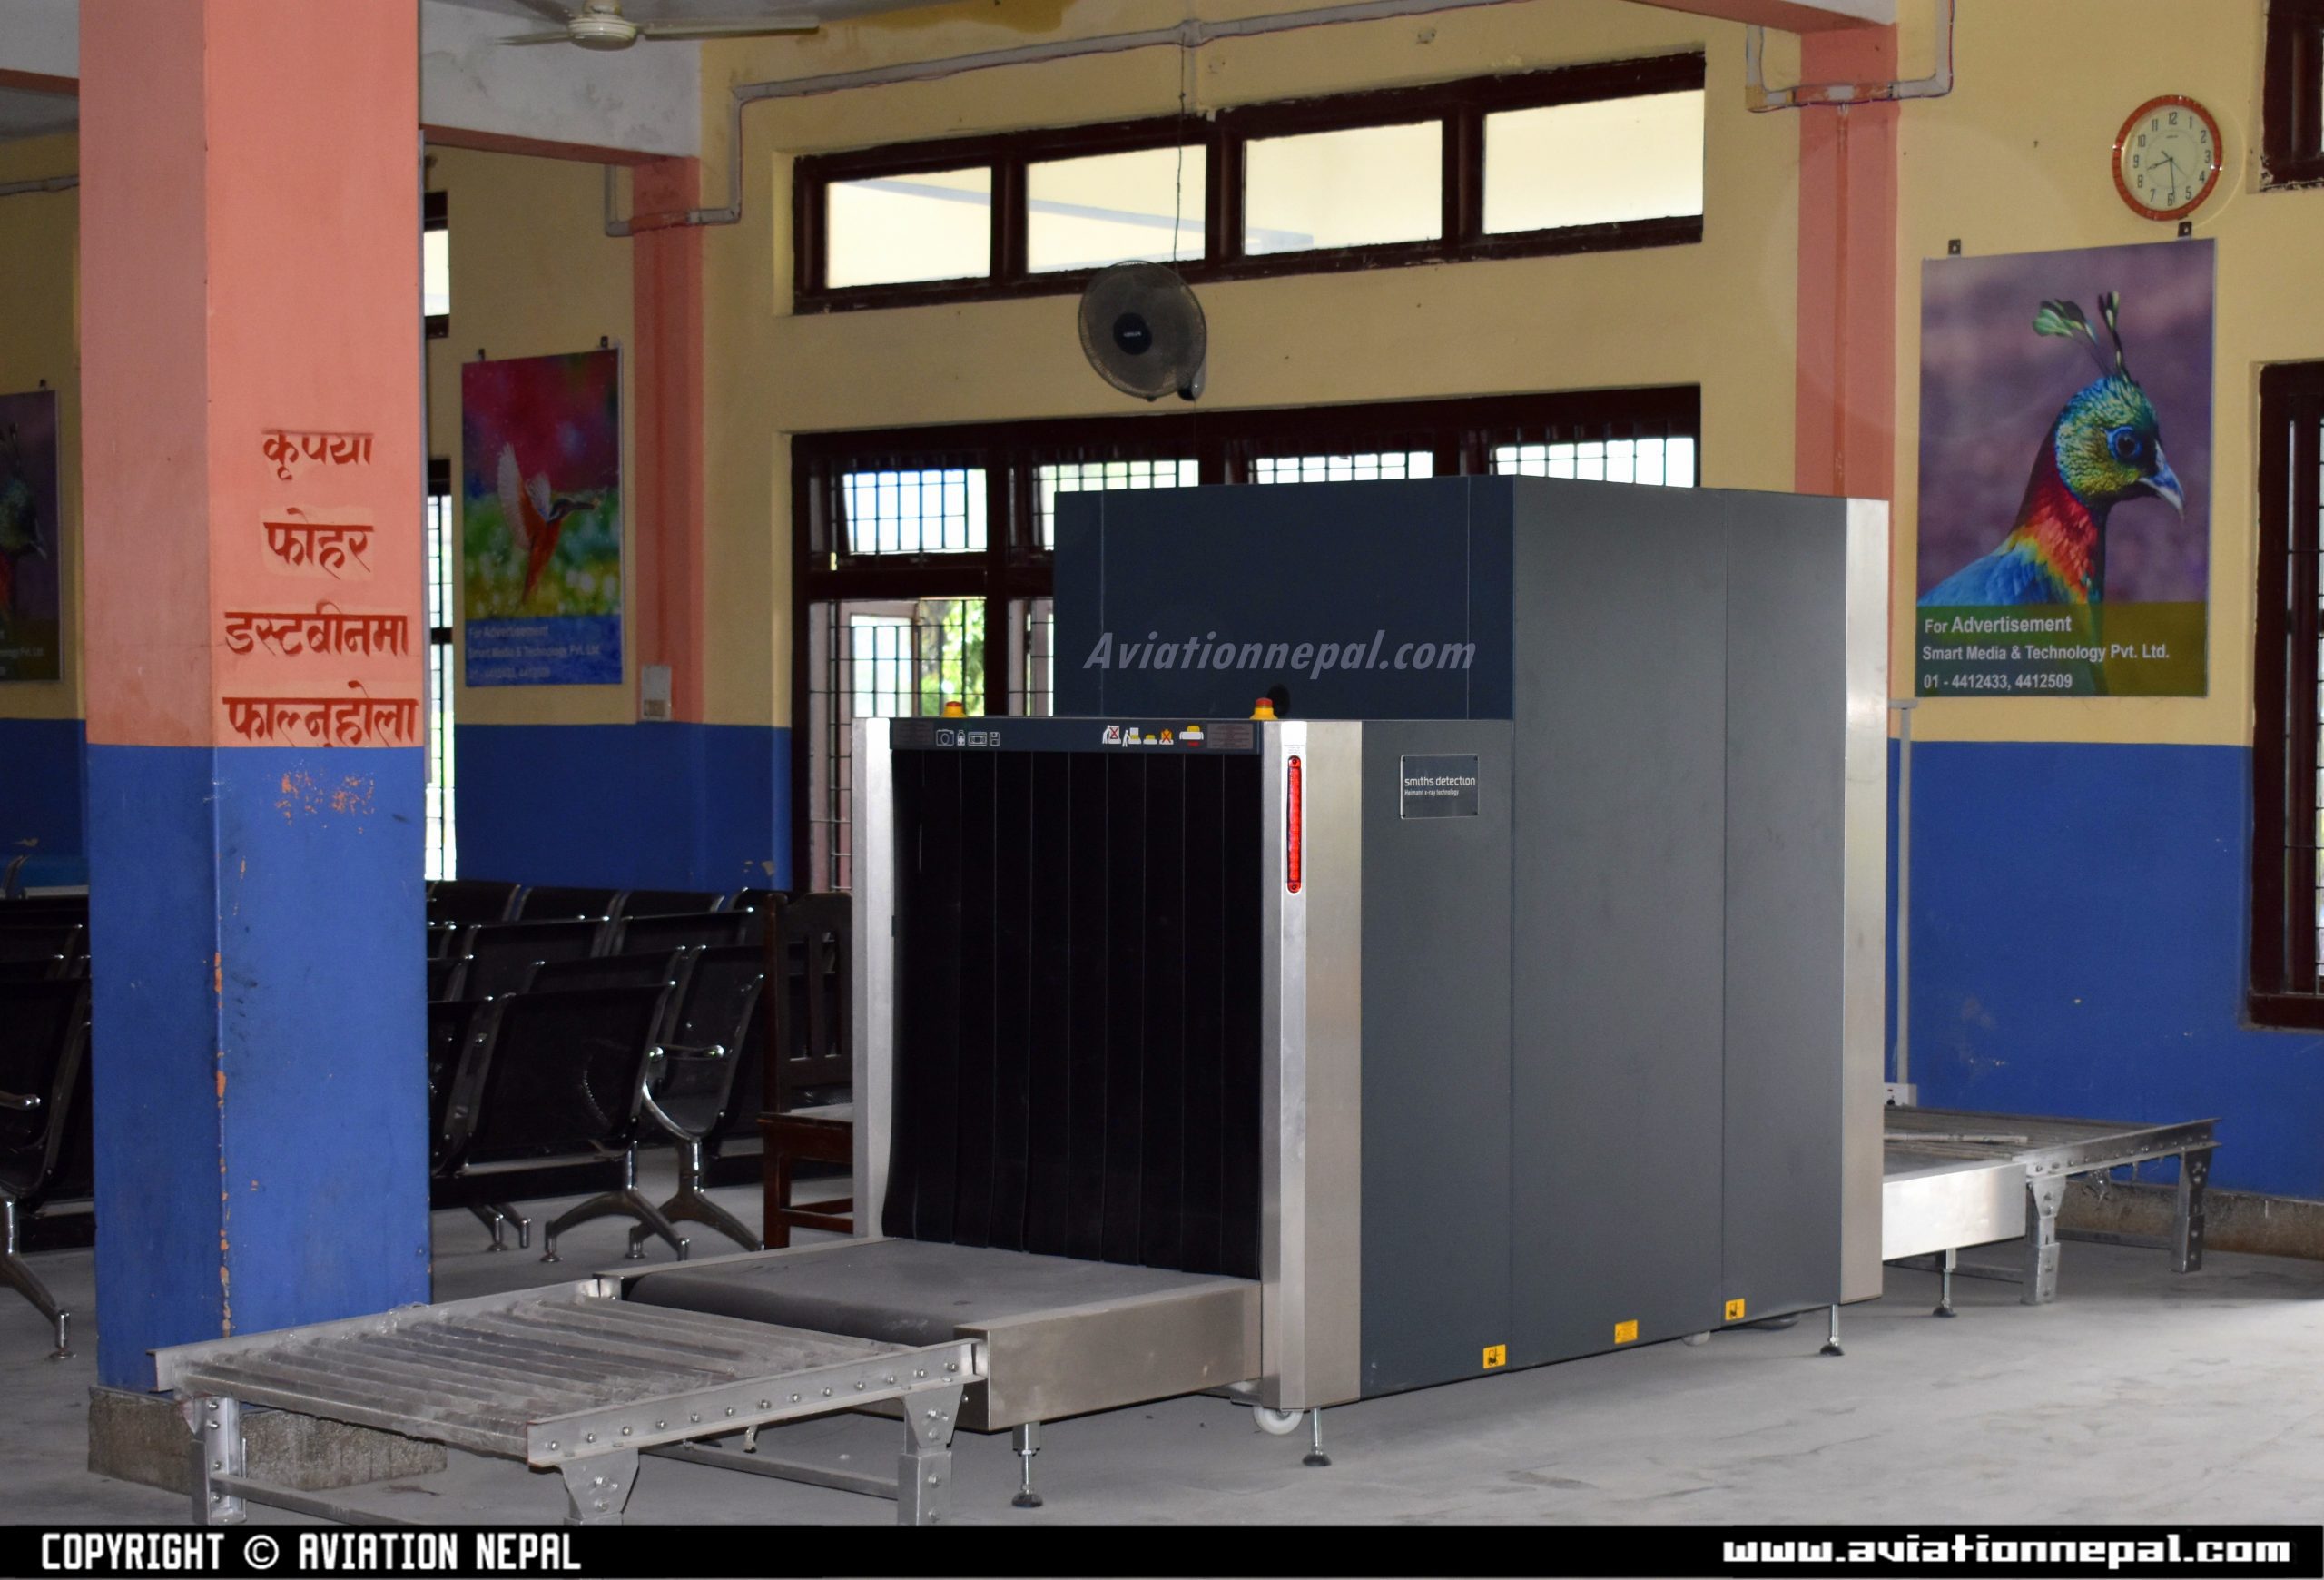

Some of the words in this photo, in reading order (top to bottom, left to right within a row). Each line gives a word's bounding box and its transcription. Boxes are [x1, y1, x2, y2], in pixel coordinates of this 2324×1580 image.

[2152, 119, 2159, 132] 11
[2169, 112, 2178, 125] 12
[2138, 134, 2146, 147] 10
[2200, 130, 2207, 143] 2
[2133, 154, 2140, 168] 9
[2204, 149, 2211, 163] 3
[2137, 174, 2143, 188] 8
[2199, 170, 2206, 184] 4
[2150, 188, 2156, 202] 7
[2167, 193, 2174, 206] 6
[2185, 186, 2191, 200] 5
[261, 427, 374, 480] कृपया
[263, 507, 374, 580] फोहर
[224, 599, 408, 657] डस्टबीनमा
[1925, 619, 1948, 634] For
[1952, 616, 2072, 634] Advertisement
[1923, 646, 1963, 661] Smart
[1966, 646, 2006, 661] Media
[2011, 646, 2022, 660] &
[2024, 644, 2106, 663] Technology
[2110, 644, 2137, 659] Pvt.
[2142, 644, 2170, 659] Ltd.
[1924, 676, 1939, 689] 01
[1952, 675, 2012, 690] 4412433,
[2015, 674, 2073, 689] 4412509
[222, 680, 419, 747] फाल्नहोला
[1404, 776, 1434, 787] smiths
[1435, 775, 1476, 786] detection
